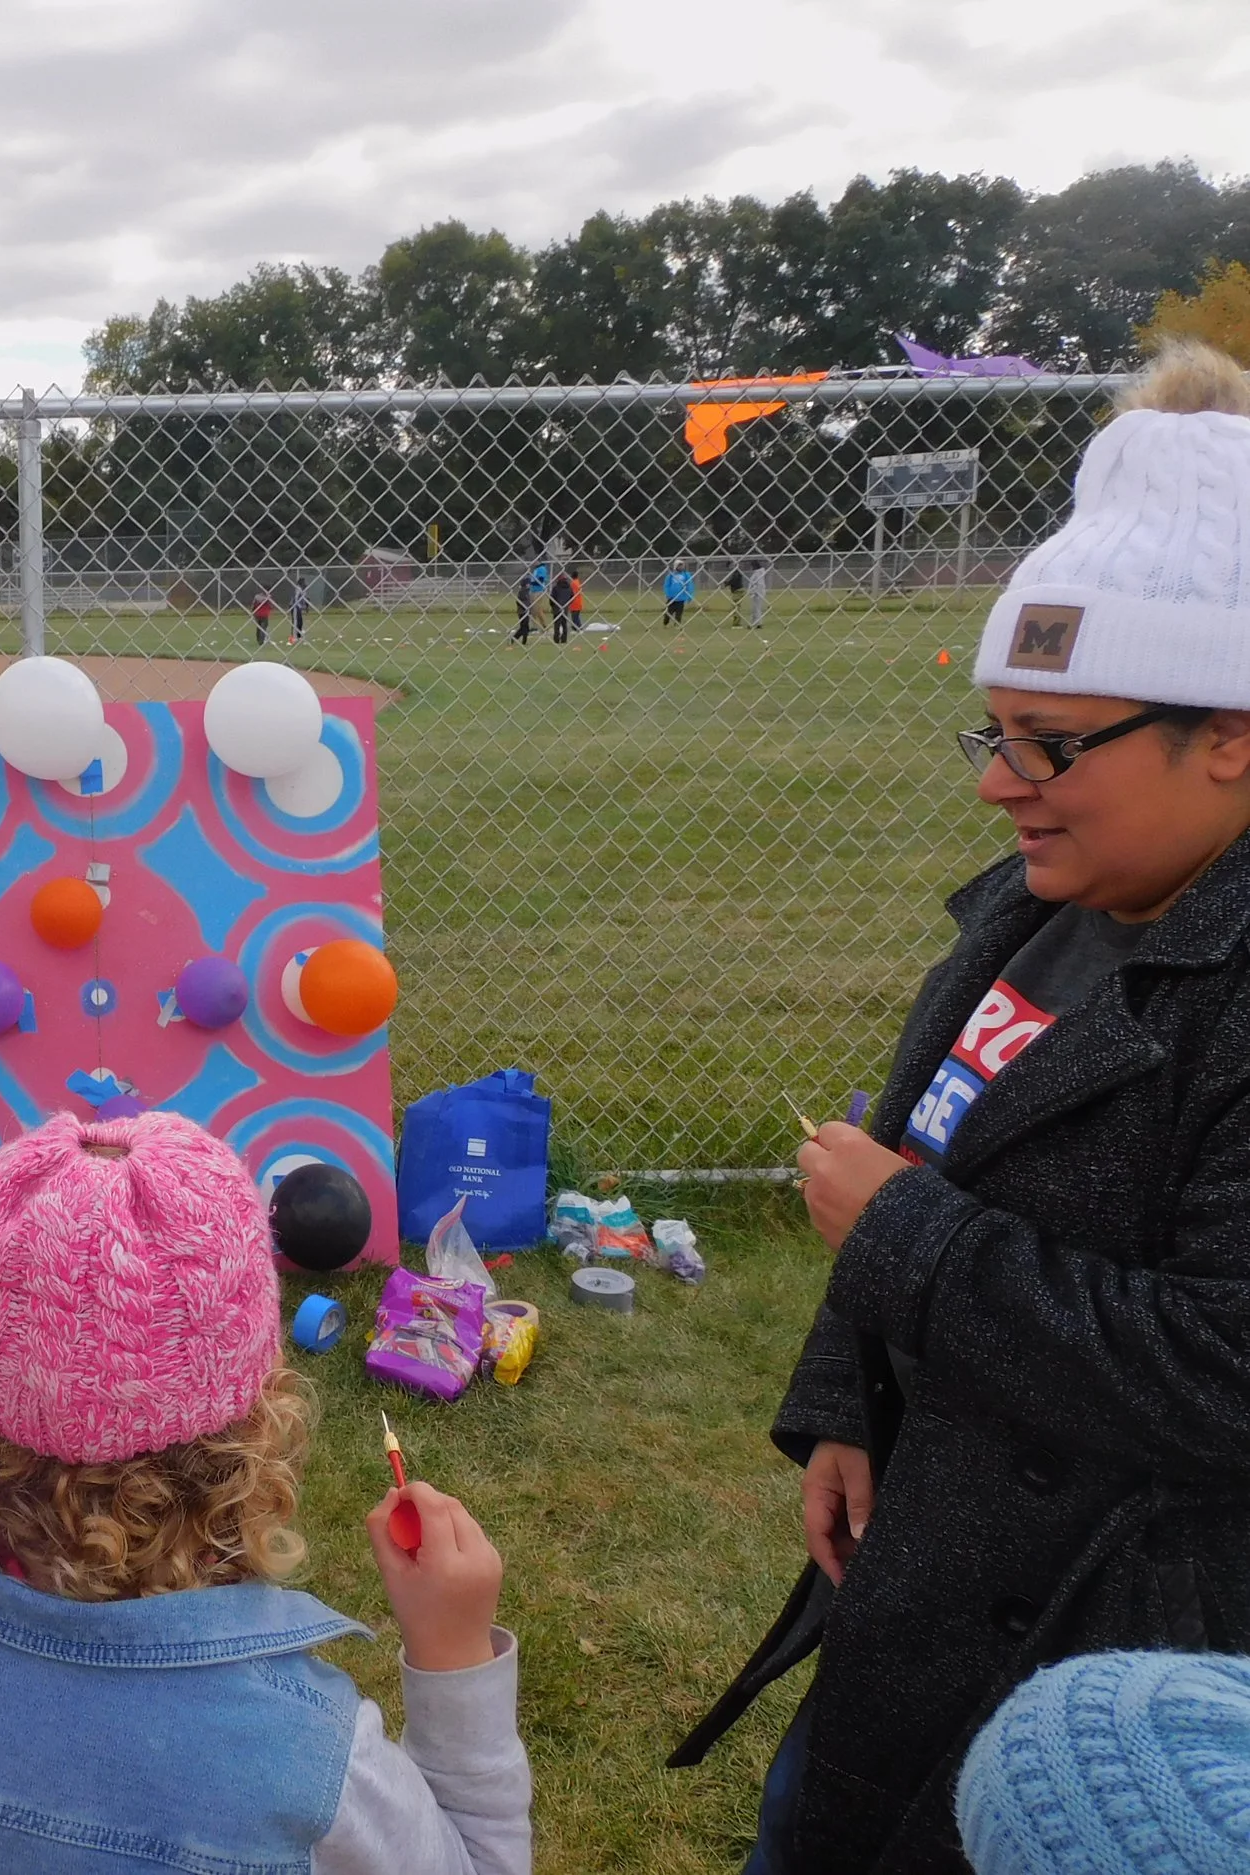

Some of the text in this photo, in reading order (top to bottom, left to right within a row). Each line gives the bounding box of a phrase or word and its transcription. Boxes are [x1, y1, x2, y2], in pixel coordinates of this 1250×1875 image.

[1018, 620, 1068, 656] M
[448, 1165, 501, 1177] OLD NATIONAL
[462, 1174, 483, 1183] BANK
